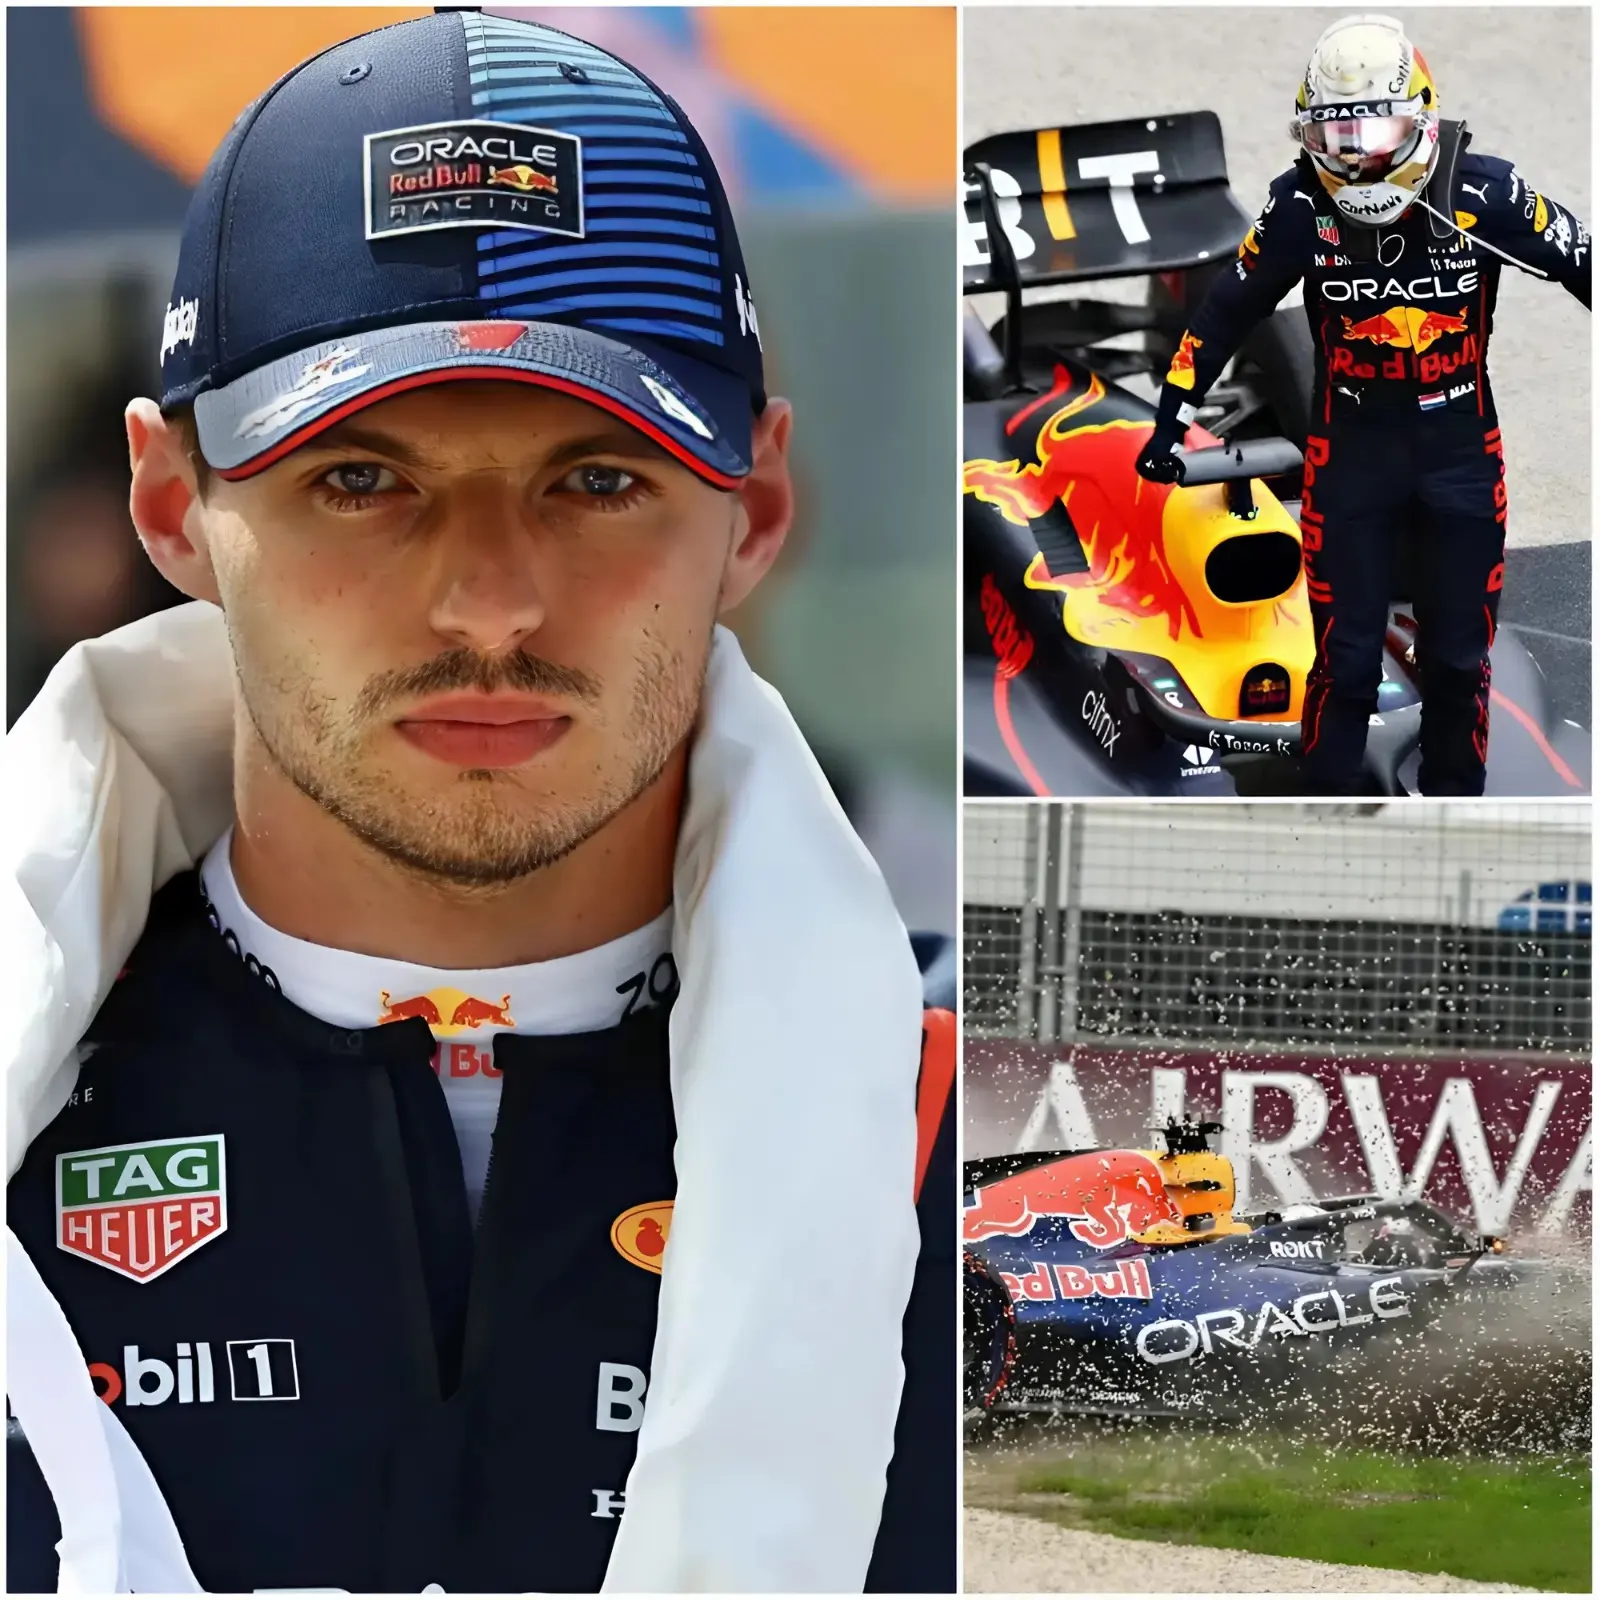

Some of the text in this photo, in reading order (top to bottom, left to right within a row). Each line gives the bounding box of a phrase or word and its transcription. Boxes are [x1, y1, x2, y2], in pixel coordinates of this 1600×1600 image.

[390, 136, 558, 167] ORACLE
[390, 163, 481, 194] Red Bull
[390, 195, 561, 219] RACING
[1321, 271, 1479, 301] ORACLE
[71, 1148, 209, 1200] TAG
[68, 1201, 215, 1273] HEUER
[1053, 1257, 1153, 1300] Bull
[1135, 1276, 1411, 1365] ORACLE
